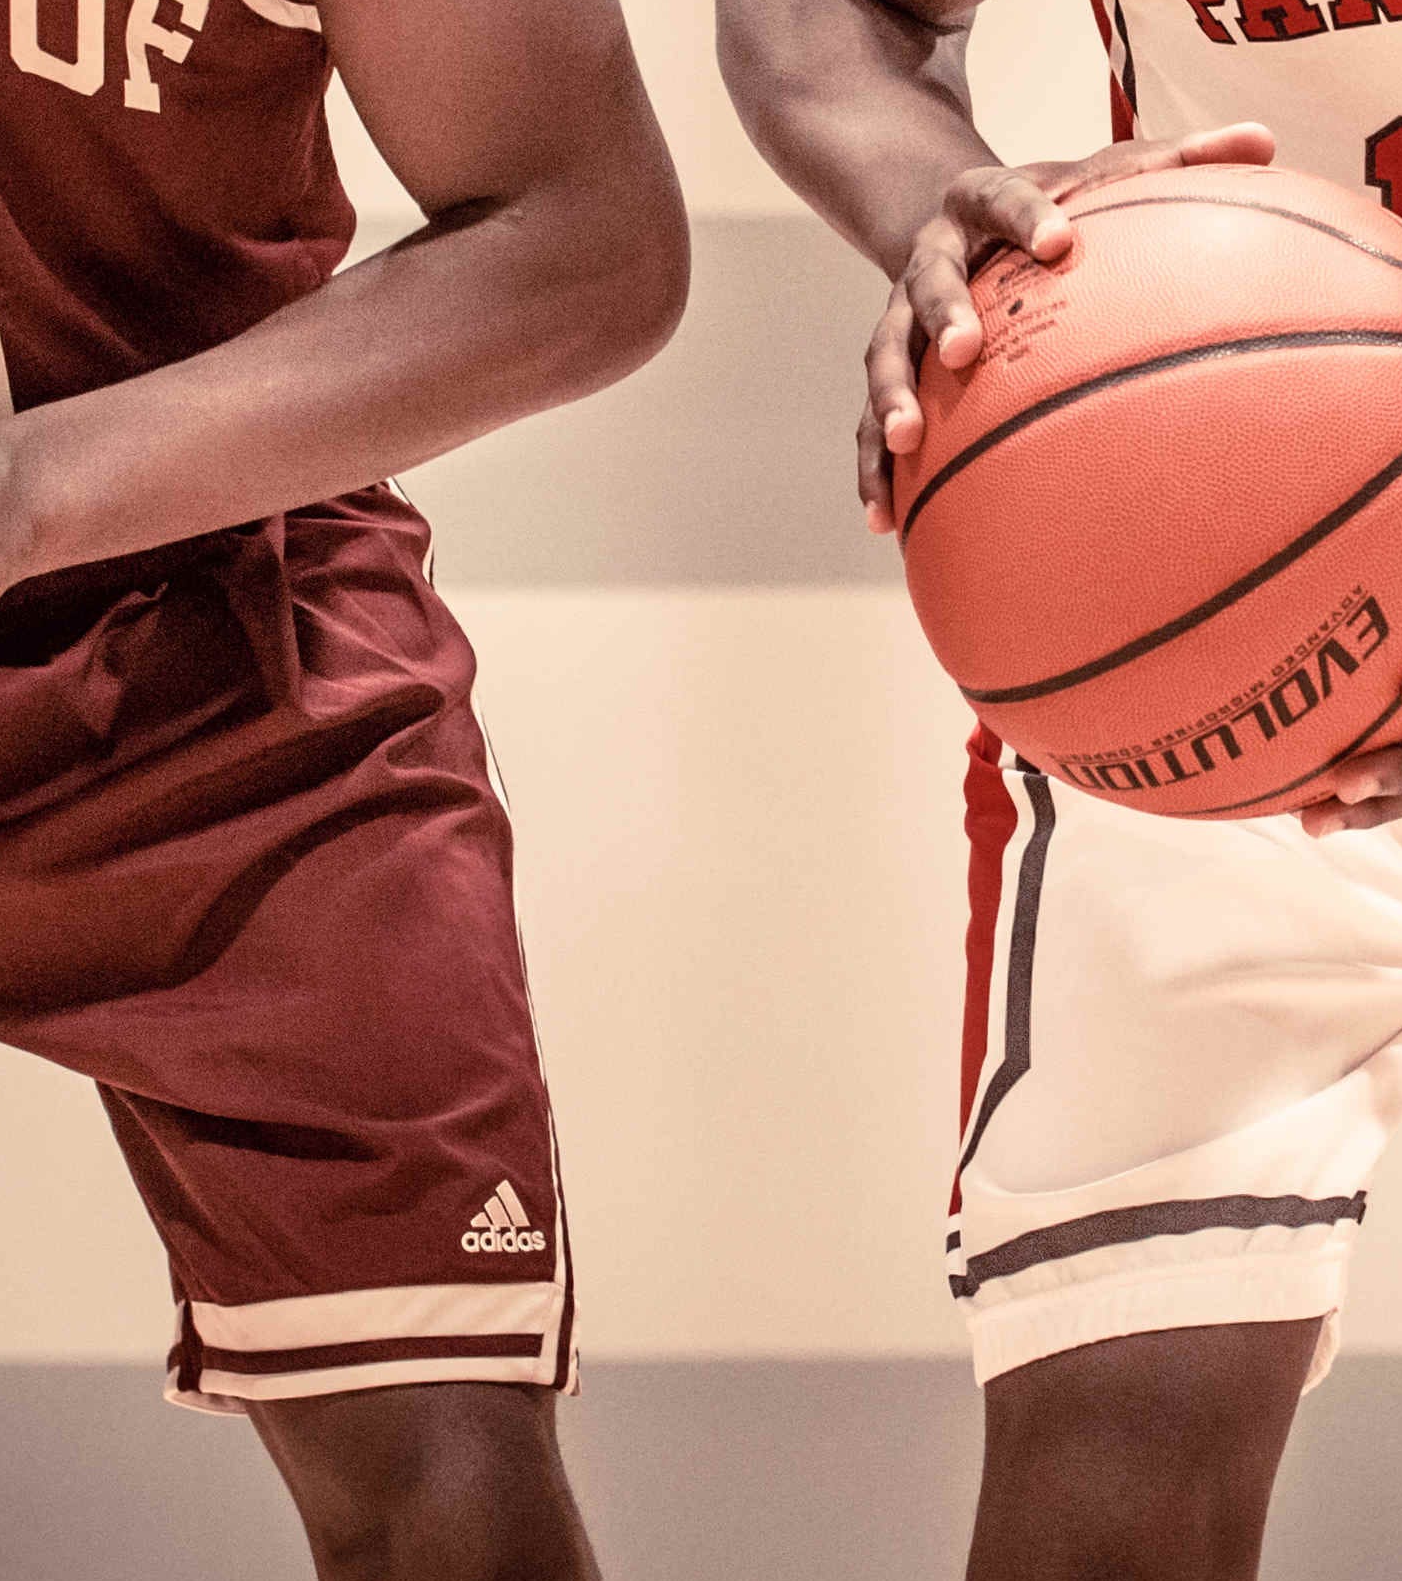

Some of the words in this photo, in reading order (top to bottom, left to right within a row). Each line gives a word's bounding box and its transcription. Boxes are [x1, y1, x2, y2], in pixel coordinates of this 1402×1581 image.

[1271, 584, 1363, 678] ADVANCED
[1059, 594, 1390, 791] EVOLUTION
[461, 1226, 547, 1253] adidas
